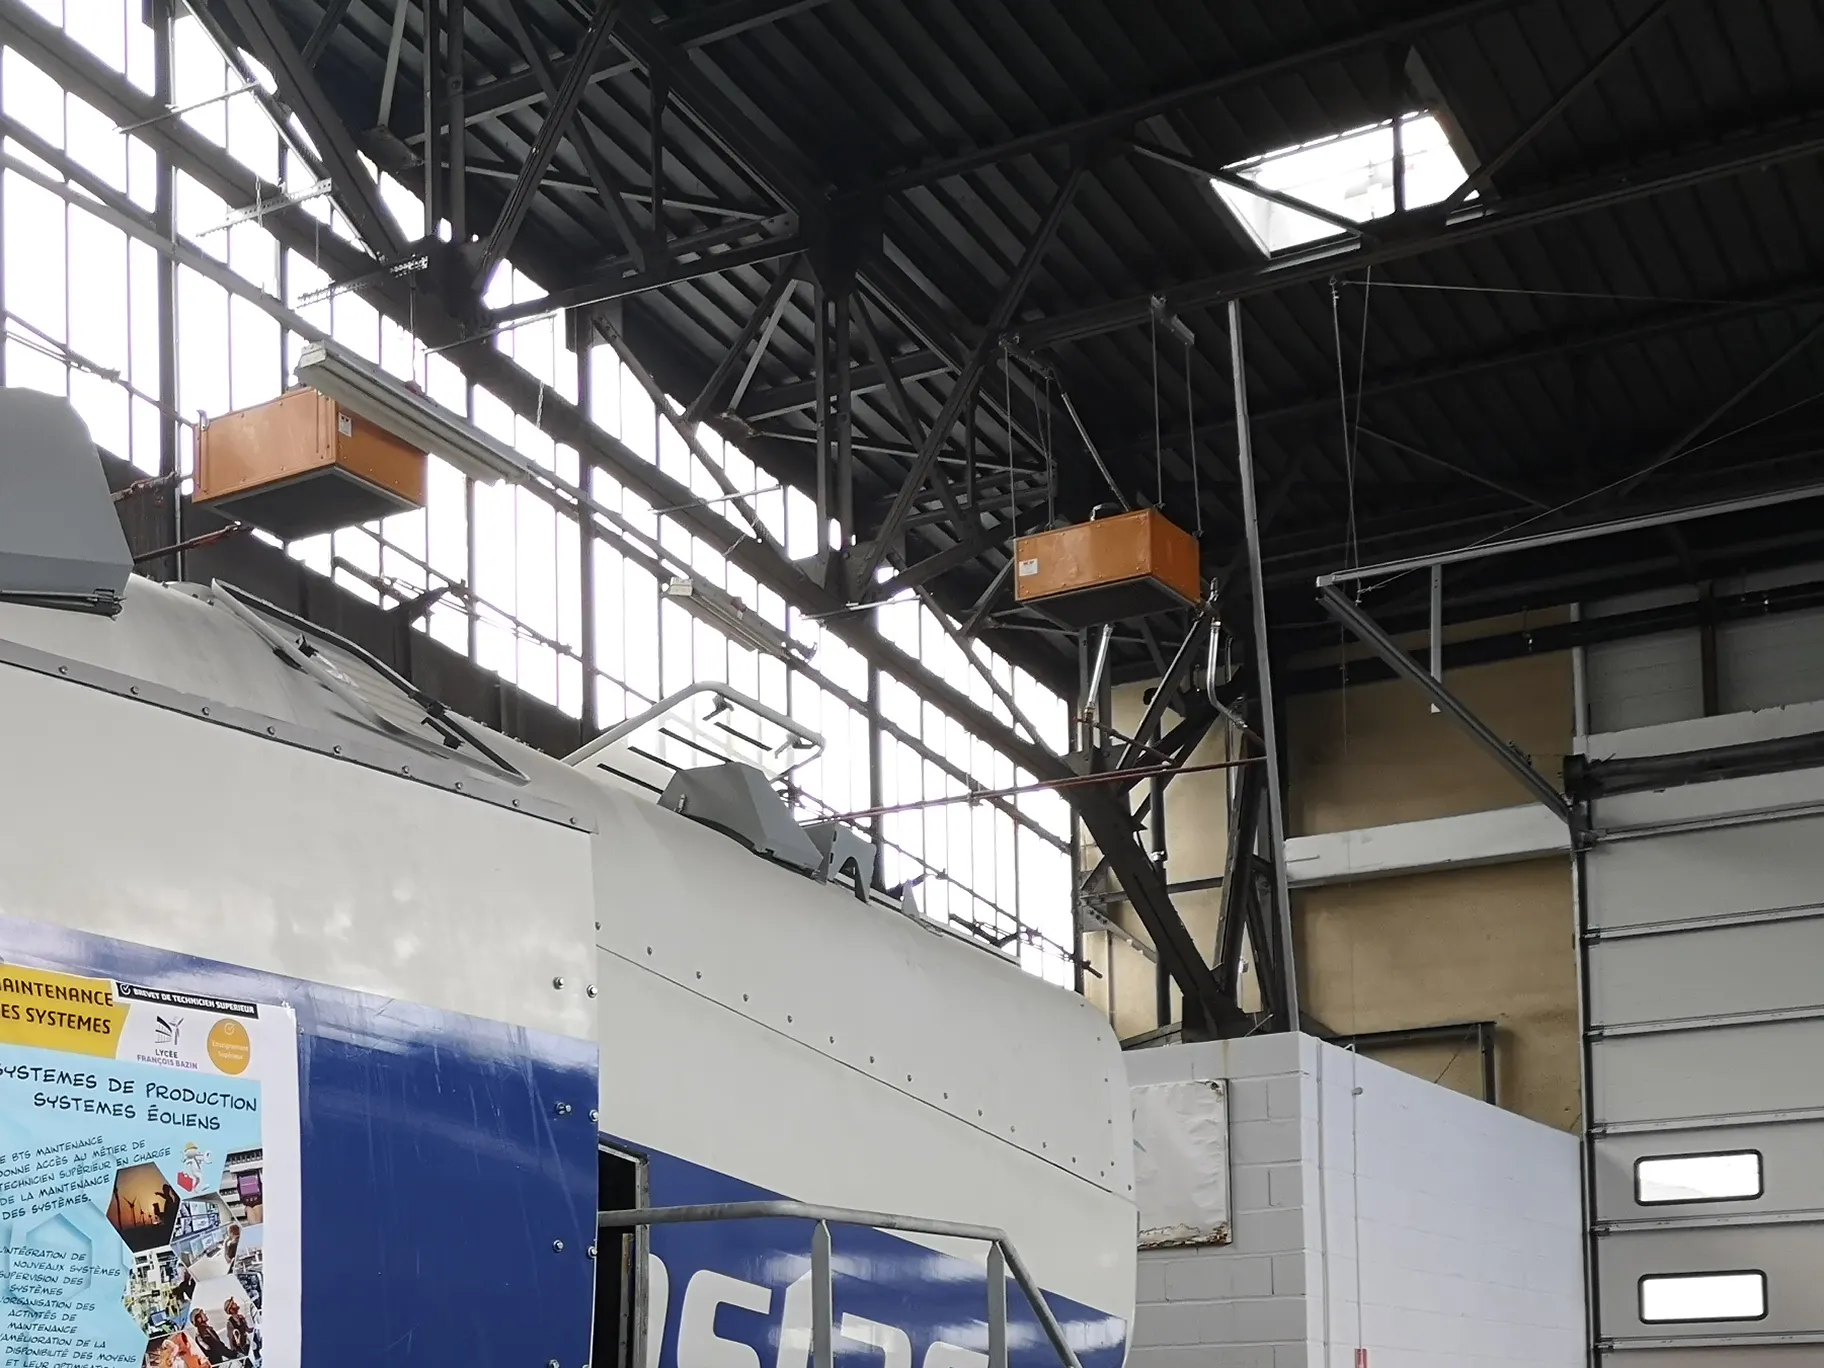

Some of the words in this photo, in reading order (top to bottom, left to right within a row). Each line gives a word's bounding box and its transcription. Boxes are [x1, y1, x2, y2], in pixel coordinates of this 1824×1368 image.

[133, 988, 160, 1000] BREVET
[162, 993, 171, 1001] DE
[172, 995, 215, 1007] TECHNICIEN
[26, 1008, 111, 1035] SYSTEMES
[137, 1055, 174, 1066] FRANÇOIS
[176, 1060, 198, 1070] BAZIN
[108, 1078, 134, 1093] DE
[146, 1083, 257, 1113] PRODUCTION
[34, 1093, 136, 1119] SYSTEMES
[148, 1105, 221, 1130] ÉOLIENS
[12, 1151, 32, 1162] BTS
[36, 1136, 103, 1157] MAINTENANCE
[36, 1154, 69, 1171] ACCÈS
[74, 1153, 87, 1163] AU
[92, 1144, 127, 1159] MÉTIER
[132, 1140, 146, 1149] DE
[60, 1160, 112, 1178] SUPÉRIEUR
[116, 1156, 129, 1167] EN
[134, 1147, 171, 1162] CHARGE
[0, 1196, 15, 1207] DE
[21, 1192, 34, 1202] LA
[39, 1174, 110, 1198] MAINTENANCE
[63, 1277, 84, 1286] DES
[7, 1323, 77, 1334] MAINTENANCE
[5, 1359, 19, 1367] ET
[23, 1360, 50, 1368] LEUR
